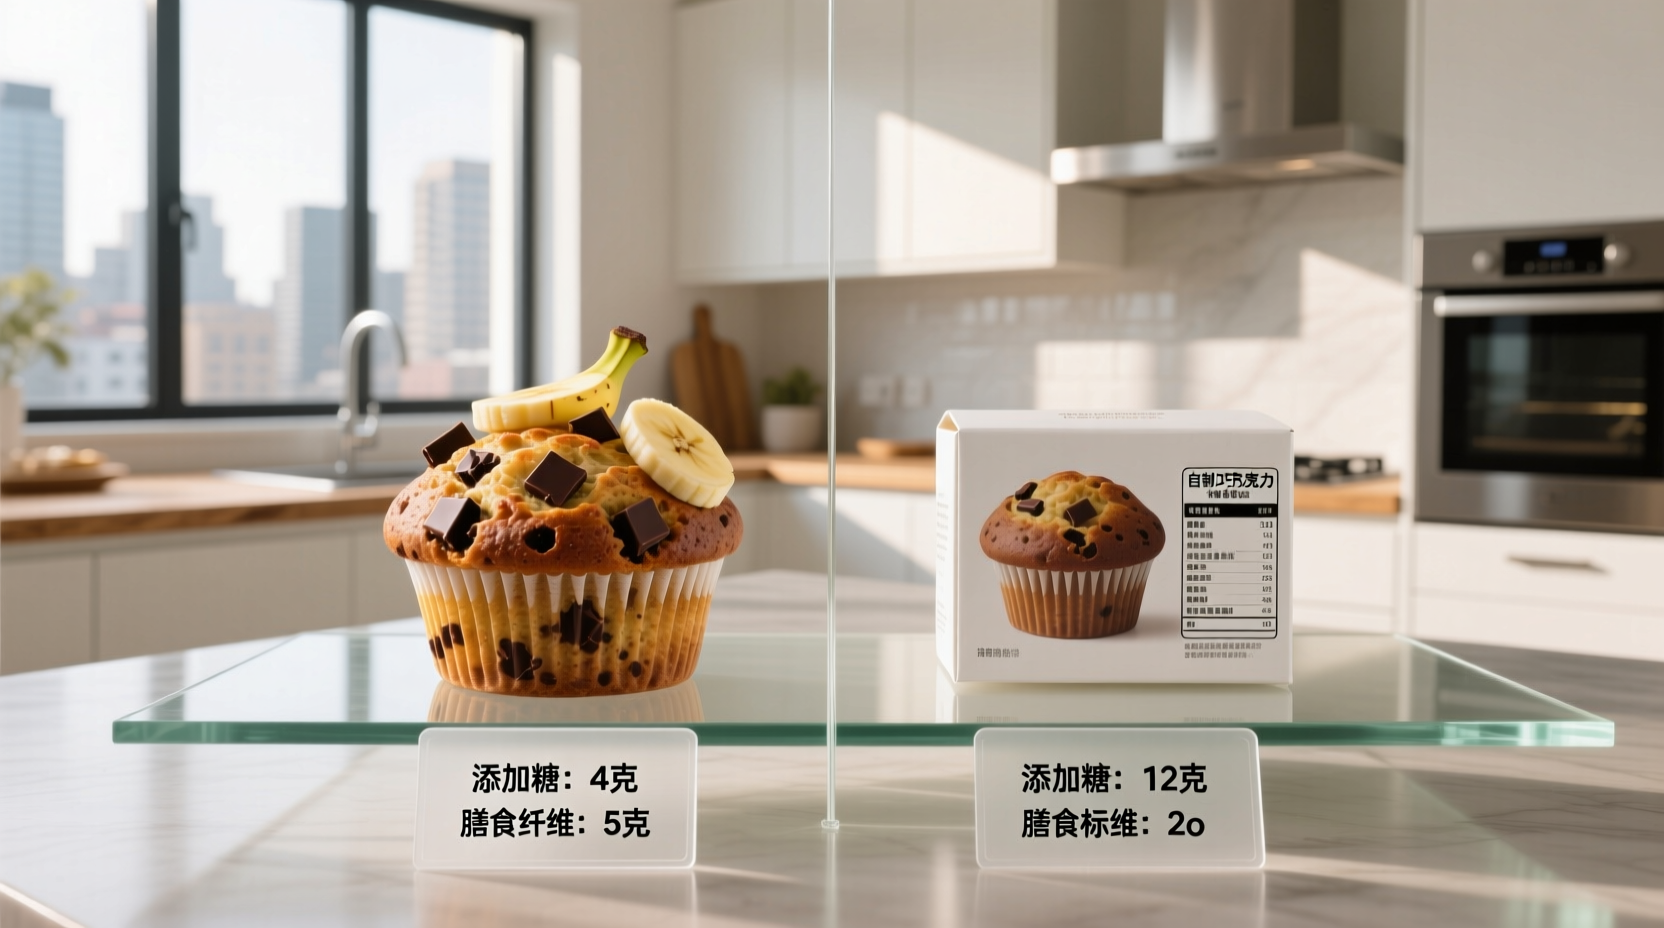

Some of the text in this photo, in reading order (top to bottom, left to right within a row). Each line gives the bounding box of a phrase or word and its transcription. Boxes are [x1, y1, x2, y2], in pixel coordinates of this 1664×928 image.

[472, 762, 638, 794] 添加糖：4克
[1021, 762, 1208, 794] 添加糖：12克
[460, 807, 651, 838] 膳食纤维：5克
